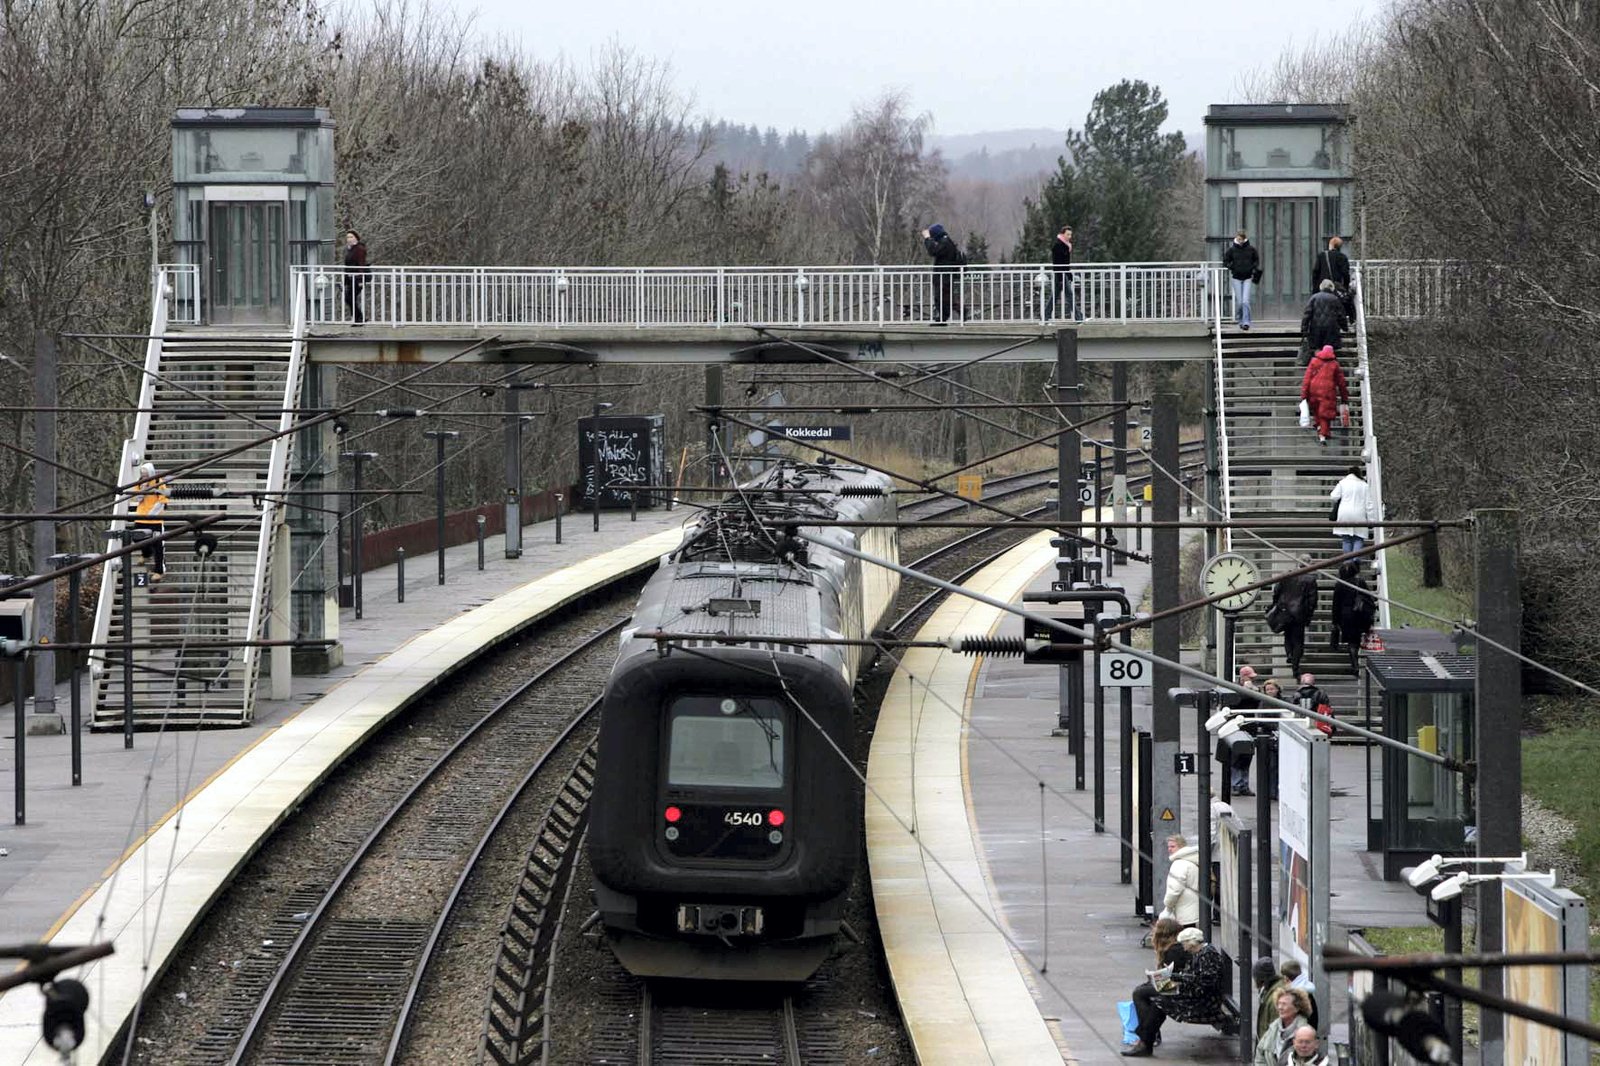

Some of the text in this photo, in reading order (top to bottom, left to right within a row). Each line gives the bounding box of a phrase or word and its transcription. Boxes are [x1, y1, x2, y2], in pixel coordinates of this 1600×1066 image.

[785, 427, 832, 437] Kokkedal
[137, 576, 145, 586] 2
[1110, 659, 1143, 680] 80
[1180, 760, 1189, 772] 1
[724, 812, 763, 826] 4540
